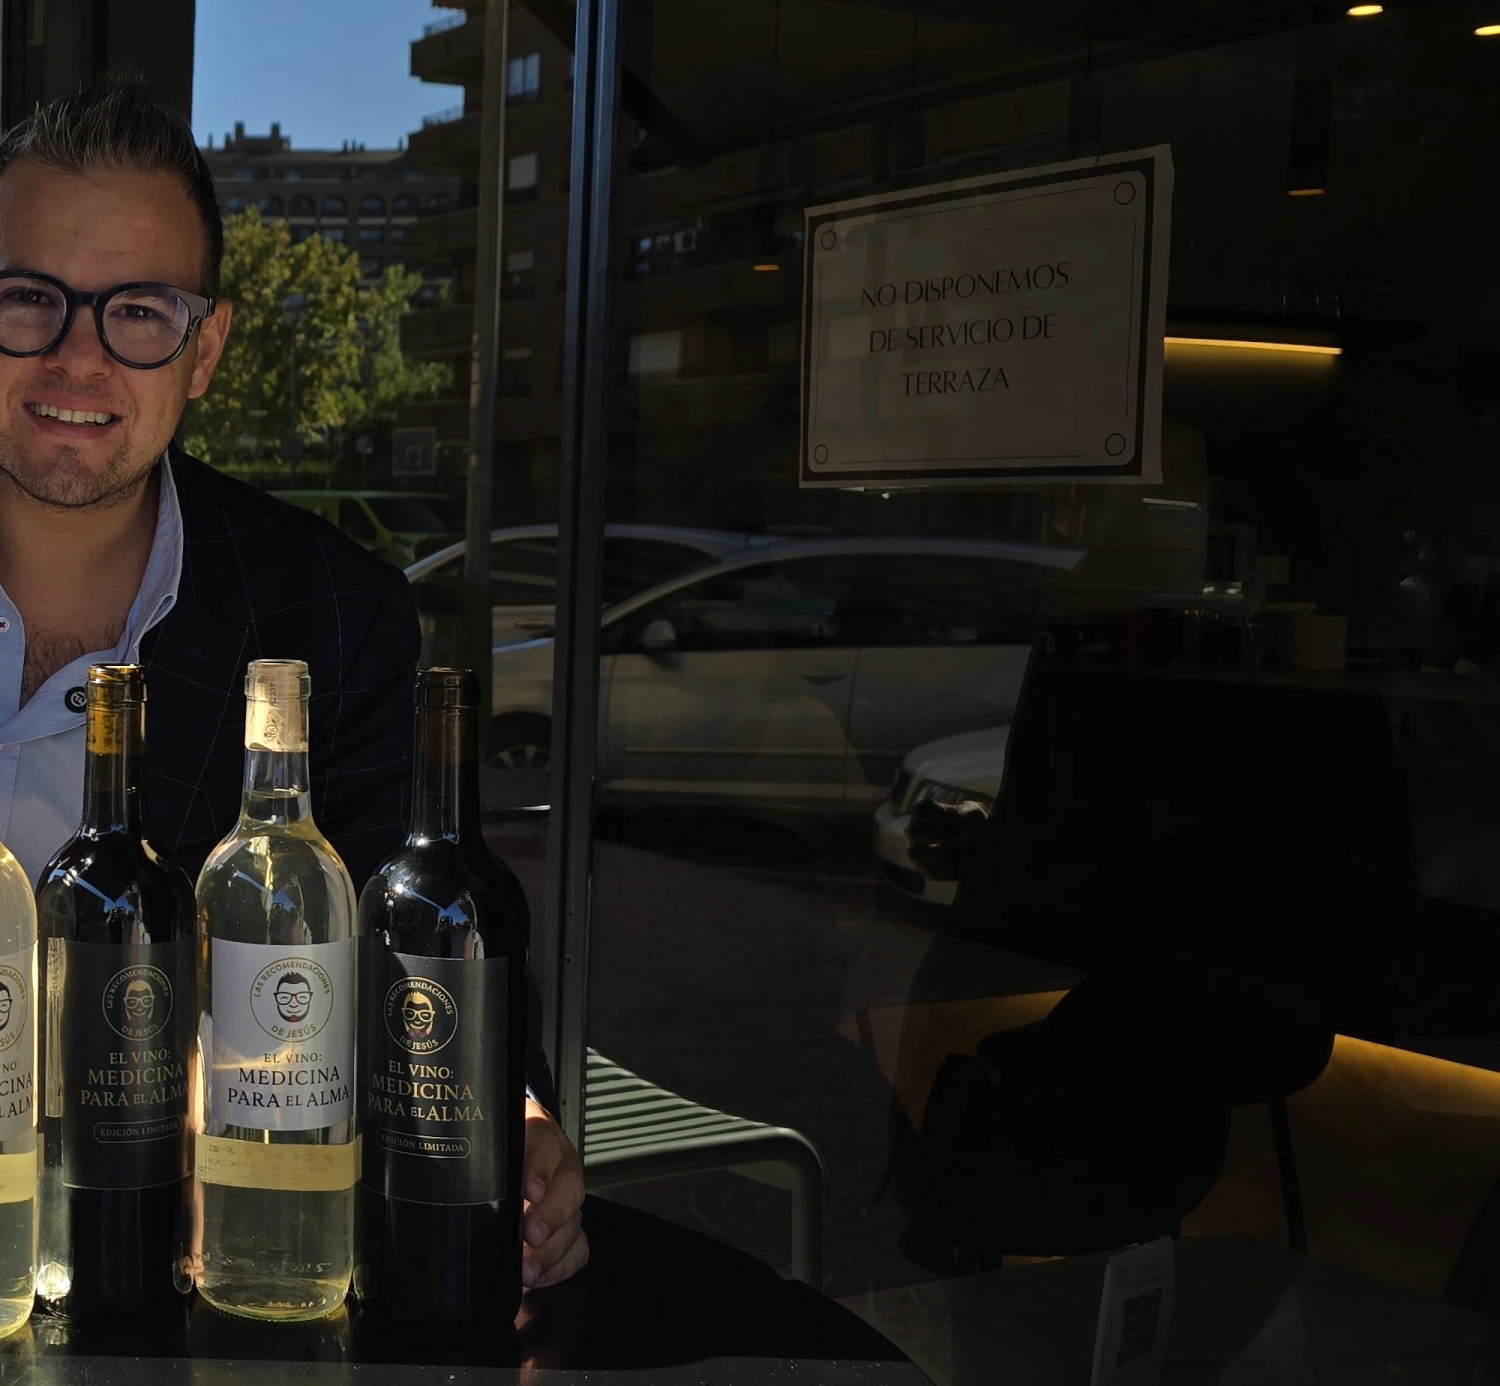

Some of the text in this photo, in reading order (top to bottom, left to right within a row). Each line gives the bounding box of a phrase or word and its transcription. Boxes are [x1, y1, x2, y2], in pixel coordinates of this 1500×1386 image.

[861, 262, 1069, 309] NO DISPONEMOS
[869, 314, 1054, 353] DE SERVICIO DE
[901, 367, 1010, 396] TERRAZA
[106, 967, 170, 1009] LAS RECOMENDACIONES
[254, 961, 330, 998] LAS RECOMENDACIONES
[389, 981, 453, 1015] RECOMENDACIONES
[120, 1022, 158, 1036] DE JESÚS
[270, 1023, 317, 1038] DE JESÚS
[400, 1036, 439, 1050] DE JESÚS
[109, 1048, 171, 1065] EL VINO:
[264, 1052, 323, 1064] EL VINO:
[87, 1062, 184, 1086] MEDICINA
[238, 1066, 340, 1086] MEDICINA
[388, 1060, 454, 1079] EL VINO:
[80, 1083, 190, 1107] PARA EL ALMA
[227, 1085, 349, 1108] PARA EL ALMA
[372, 1074, 474, 1100] MEDICINA
[7, 1094, 36, 1118] ALM
[368, 1092, 485, 1122] PARA EL ALMA
[100, 1121, 179, 1137] EDICIÓN LIMITADA
[380, 1134, 464, 1153] EDICIÓN LIMITADA
